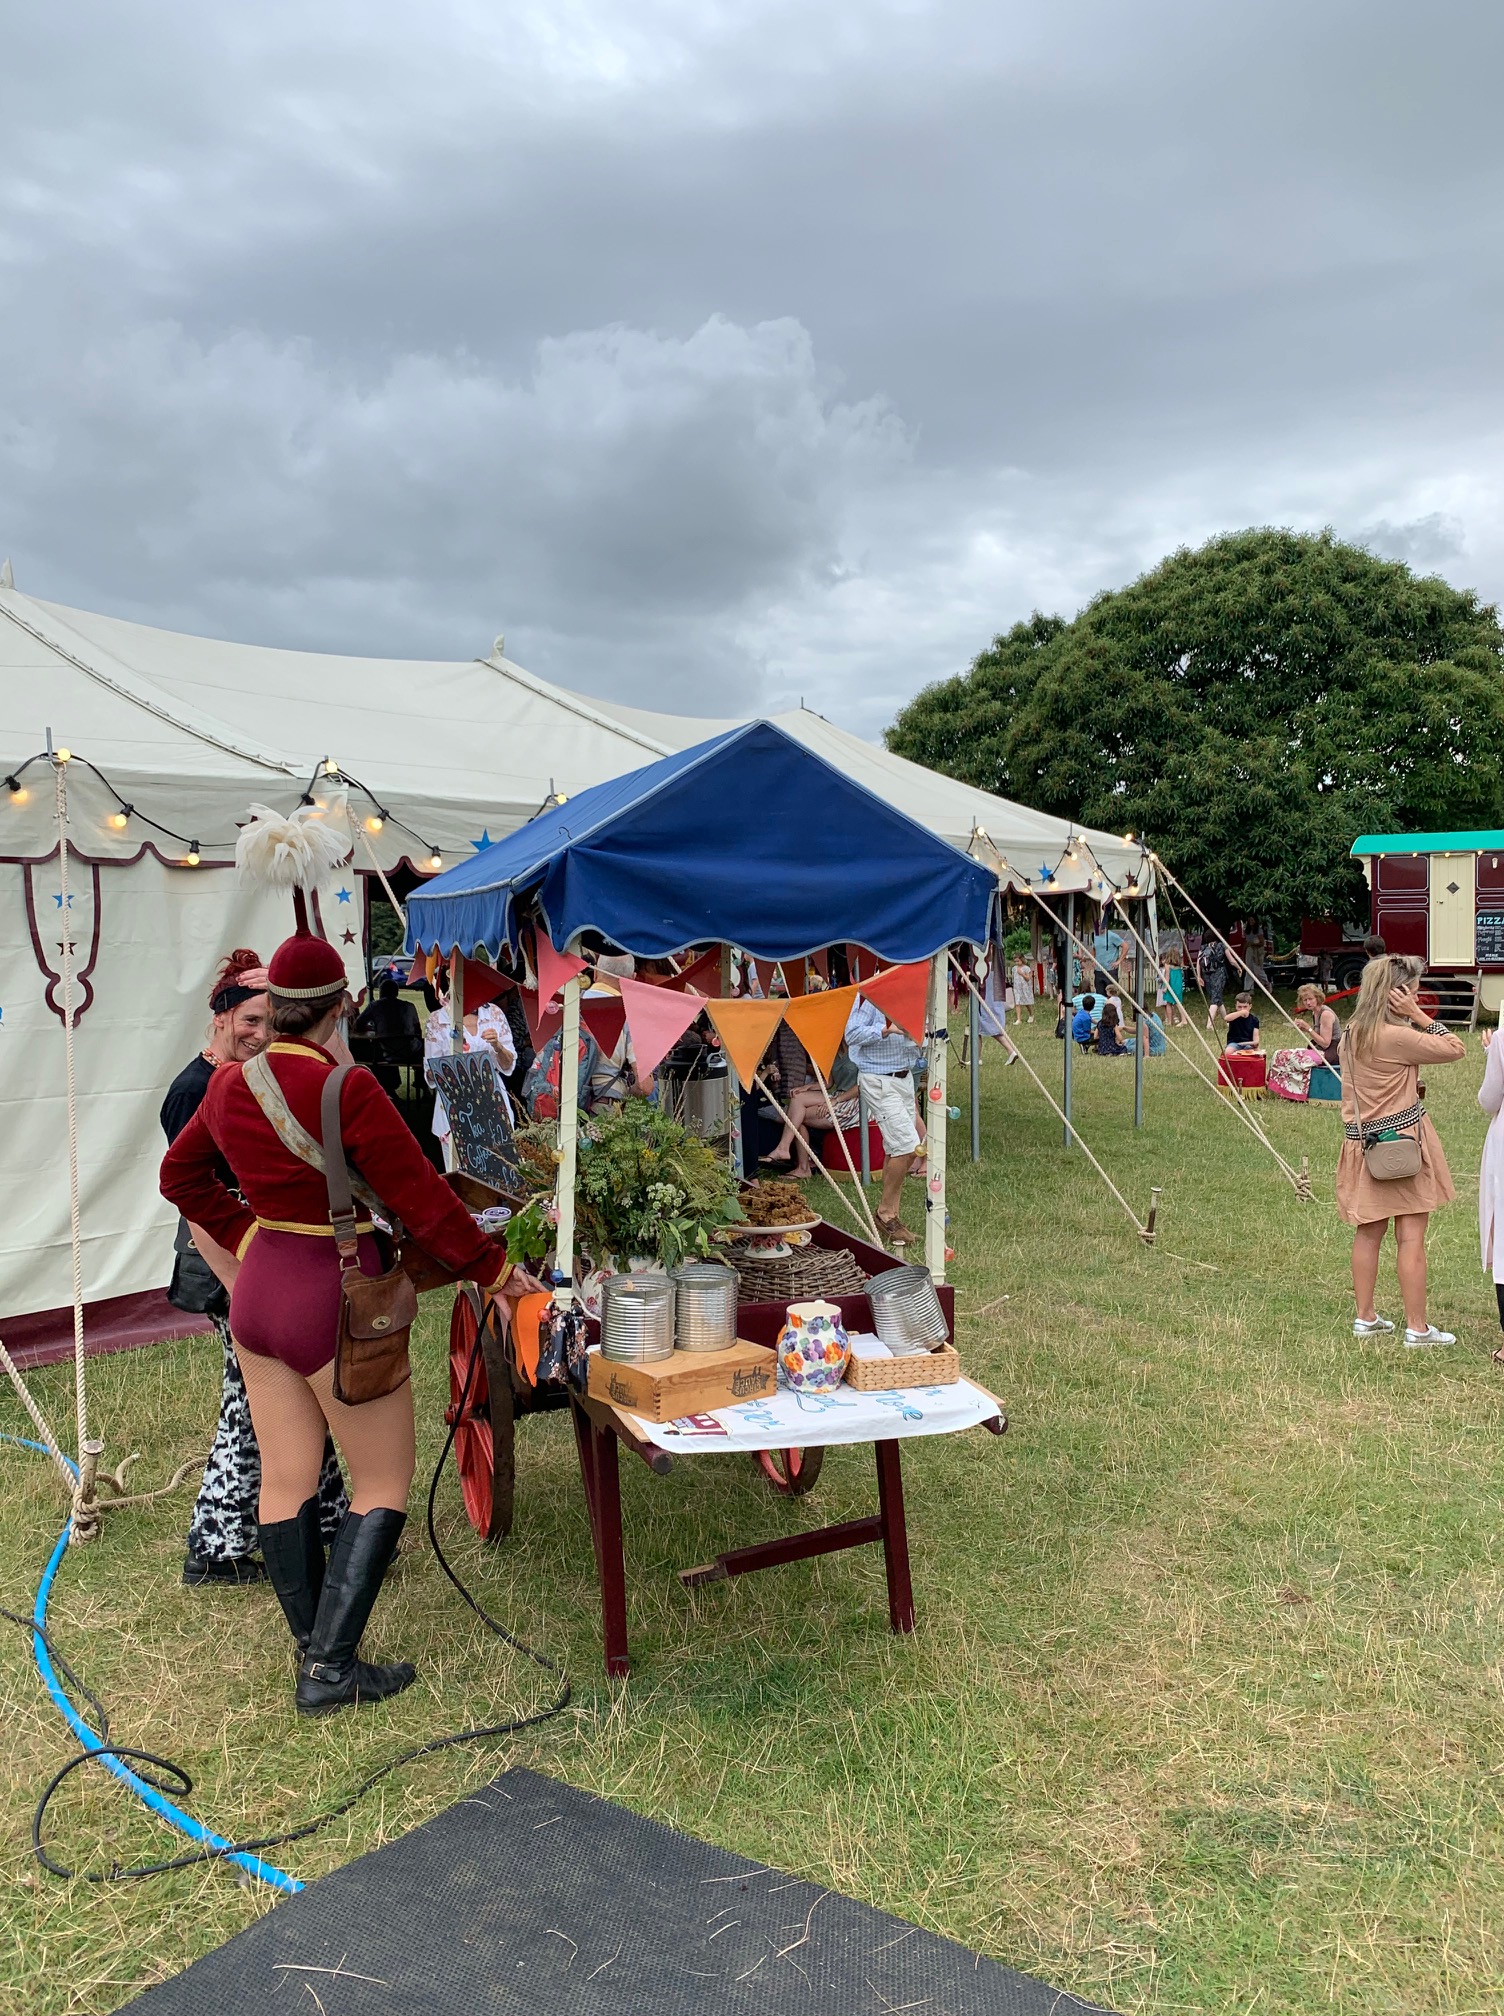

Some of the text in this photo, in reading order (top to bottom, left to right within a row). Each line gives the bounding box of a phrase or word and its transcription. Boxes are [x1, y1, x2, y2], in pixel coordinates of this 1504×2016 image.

[459, 1102, 508, 1146] Tea £2
[734, 1375, 761, 1388] SAUCE
[734, 1383, 761, 1396] CIRCUS
